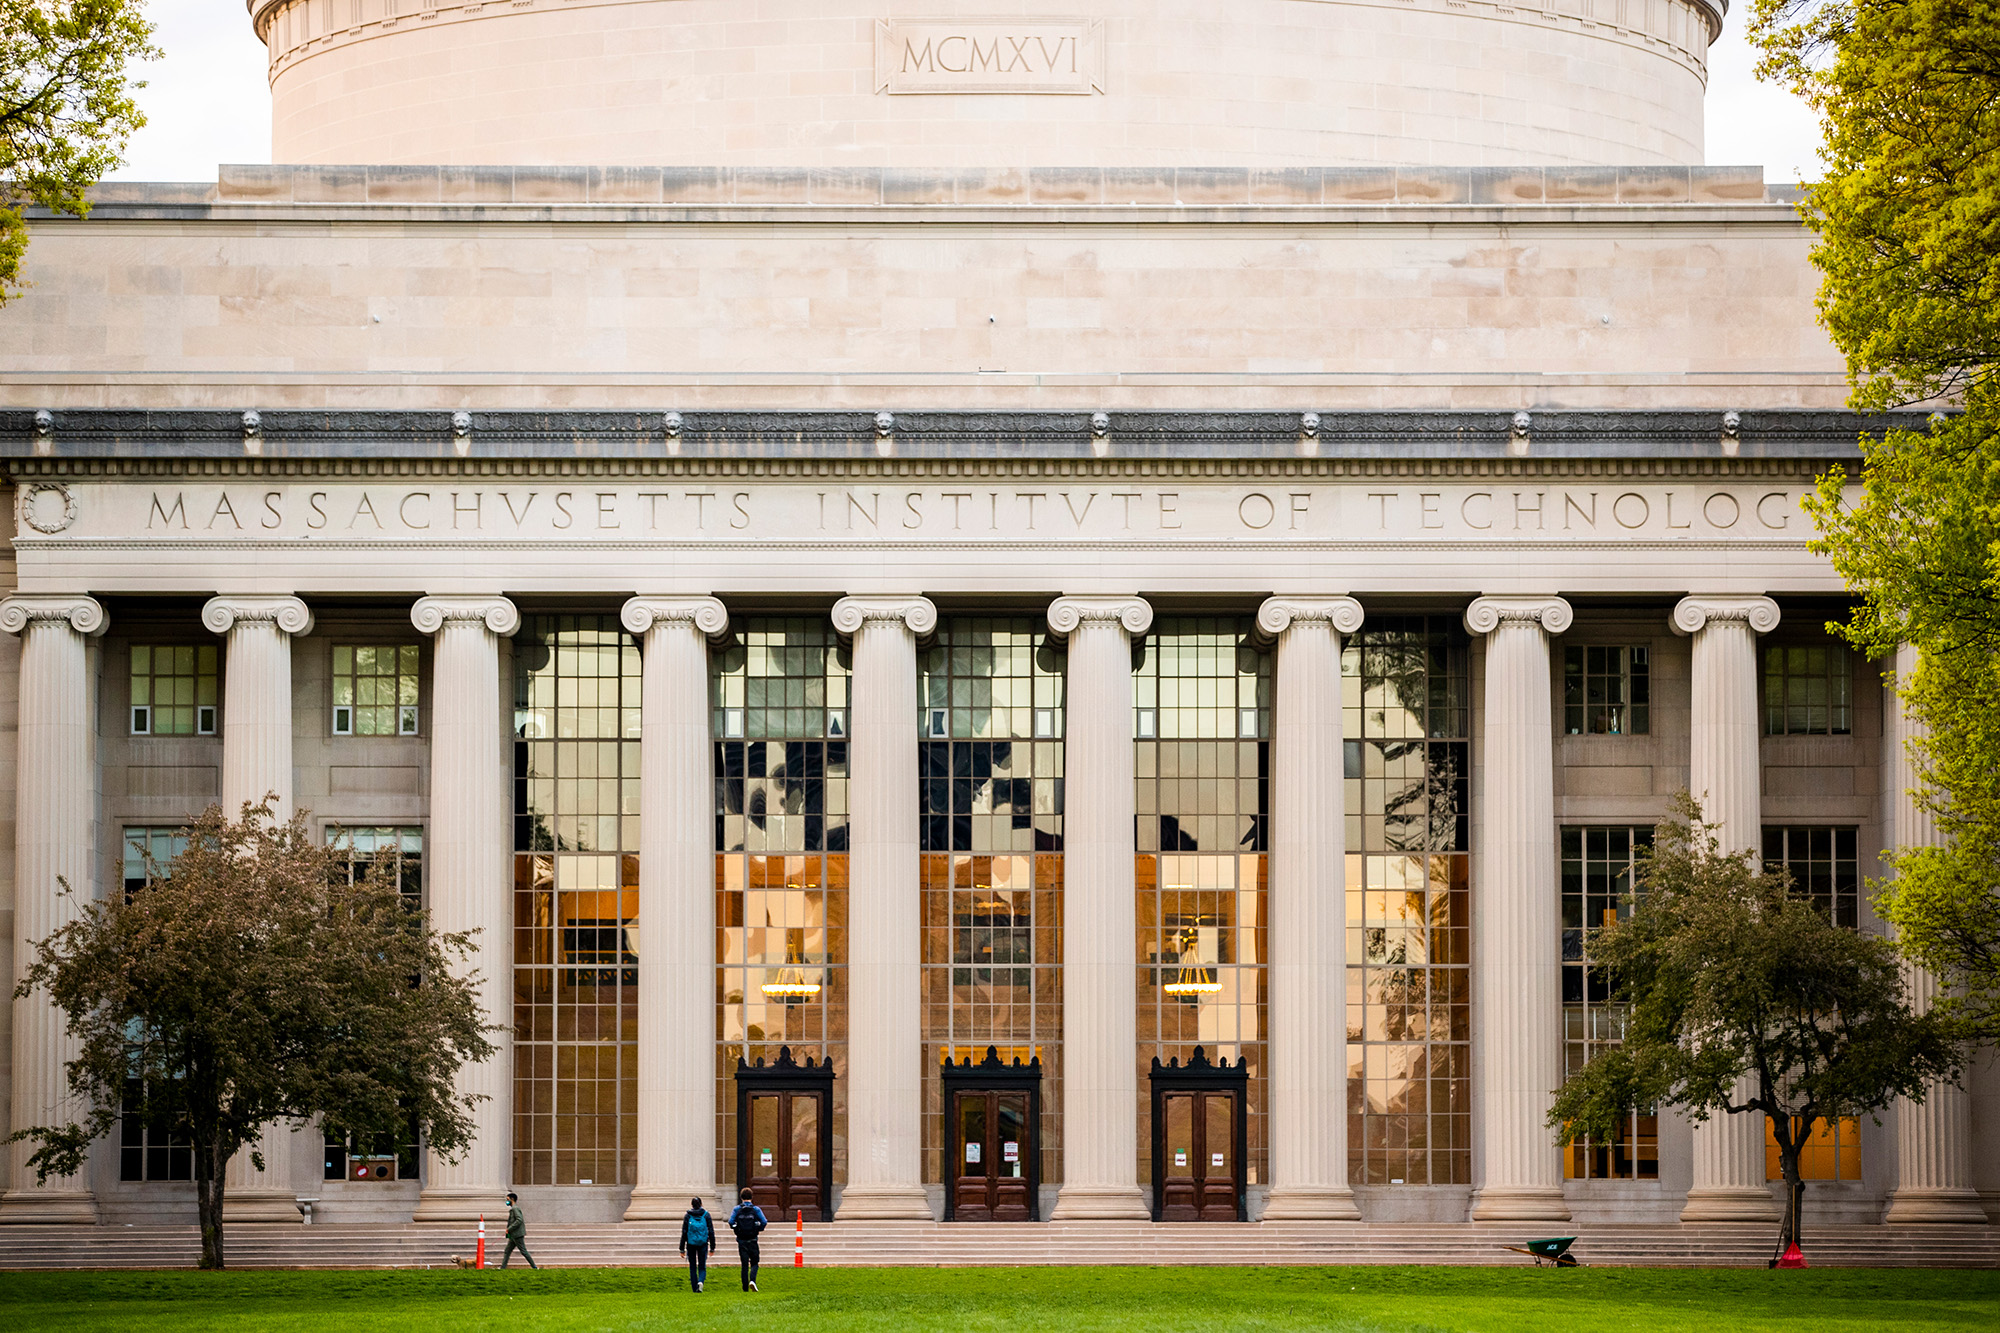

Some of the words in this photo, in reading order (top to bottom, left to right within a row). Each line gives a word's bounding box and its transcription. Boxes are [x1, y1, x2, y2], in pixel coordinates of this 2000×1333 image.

[901, 36, 1078, 73] MCMXVI
[145, 491, 751, 530] MASSACHVSETTS
[816, 492, 1183, 530] INSTITVTE
[1238, 492, 1312, 530] OF
[1367, 492, 1814, 530] TECHNOLOG
